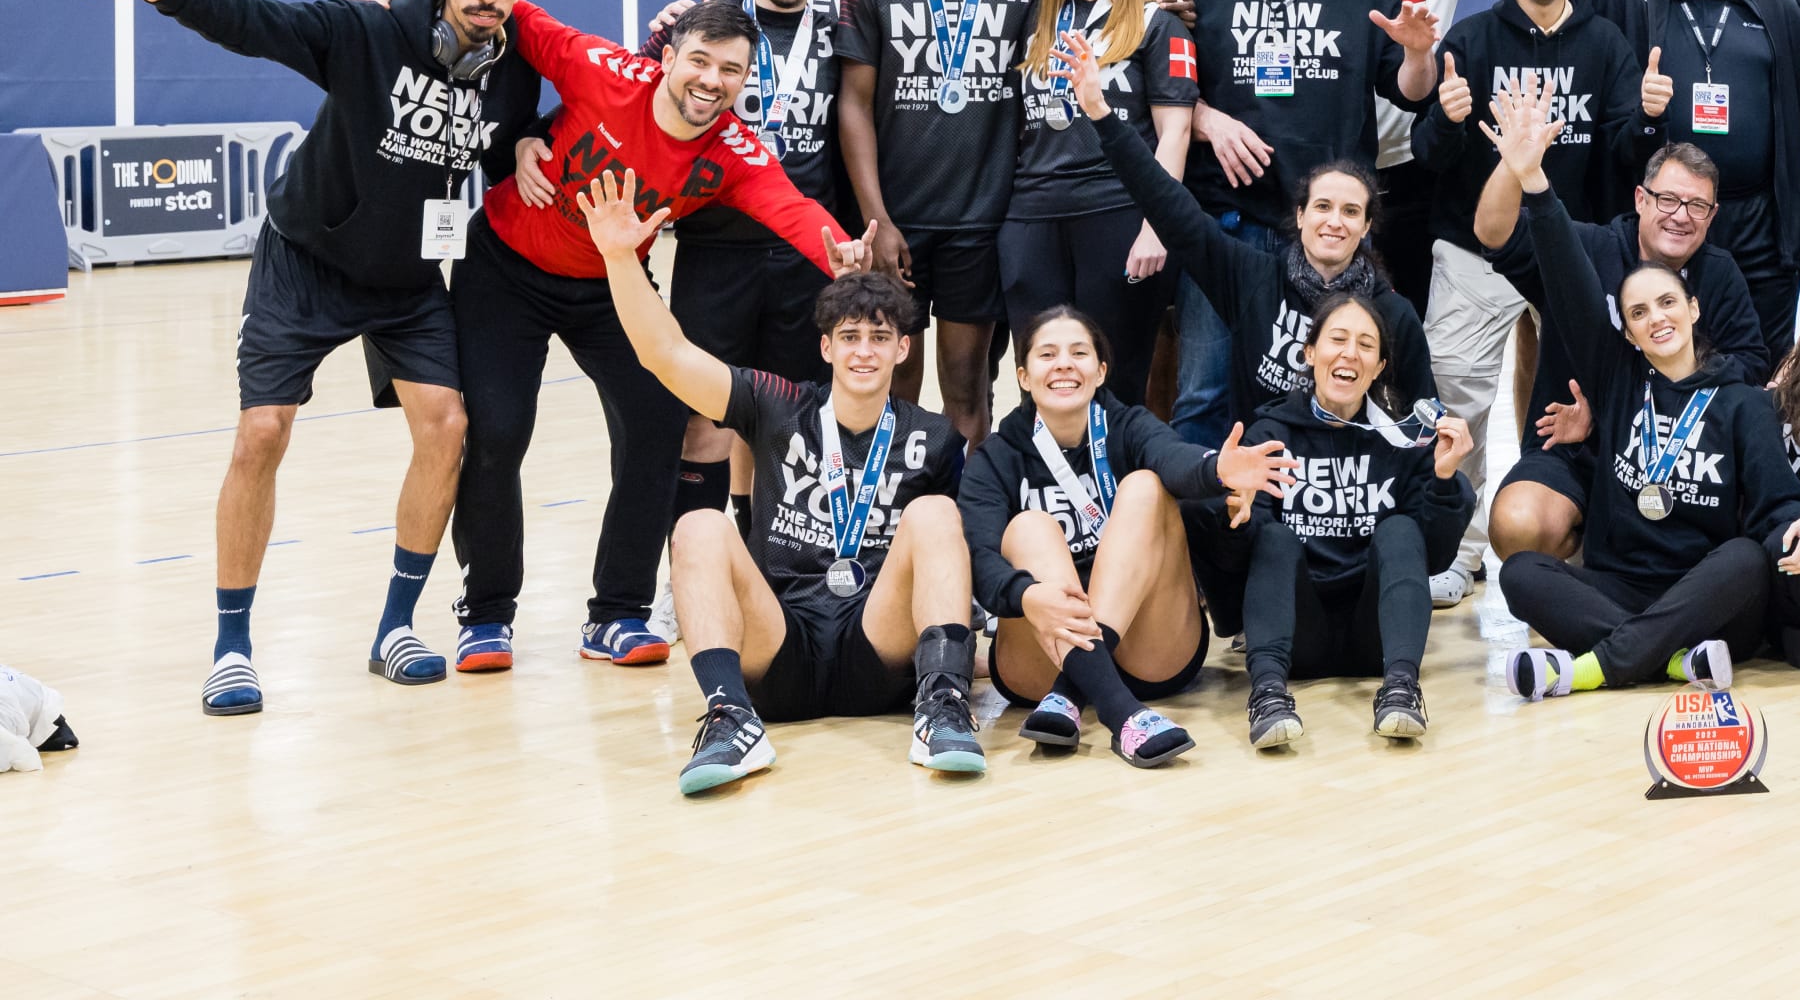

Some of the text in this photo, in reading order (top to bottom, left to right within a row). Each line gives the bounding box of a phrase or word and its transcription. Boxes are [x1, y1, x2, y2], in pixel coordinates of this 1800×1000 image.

[890, 1, 1007, 38] NEW
[1232, 2, 1322, 28] NEW
[817, 27, 833, 58] 5
[1230, 28, 1342, 57] YORK
[897, 76, 928, 89] THE
[1306, 69, 1339, 79] CLUB
[1493, 66, 1575, 94] NEW
[391, 66, 482, 118] NEW
[771, 101, 783, 114] USA
[390, 95, 499, 150] YORK
[386, 128, 407, 145] THE
[1561, 134, 1591, 144] CLUB
[380, 137, 445, 166] HANDBALL
[112, 159, 217, 187] THE PODIUM.
[130, 190, 212, 211] POWERED BY stcu
[1262, 354, 1284, 378] THE
[1684, 406, 1698, 428] verizon
[832, 452, 842, 469] USA
[871, 445, 883, 472] verizon
[905, 430, 927, 469] 6
[1280, 448, 1370, 489] NEW
[1615, 453, 1639, 477] THE
[1102, 473, 1113, 498] verizon
[1279, 477, 1396, 515] YORK
[835, 497, 845, 524] verizon
[1084, 503, 1099, 519] USA
[1681, 493, 1719, 507] CLUB
[777, 503, 807, 522] THE
[1307, 515, 1376, 528] WORLD'S
[768, 535, 802, 550] since 1973
[849, 519, 862, 545] verizon
[829, 571, 844, 579] USA
[1675, 692, 1712, 713] USA
[1675, 721, 1716, 729] HANDBALL
[1696, 731, 1716, 739] 2023
[1671, 750, 1741, 762] CHAMPIONSHIPS
[1672, 741, 1739, 753] OPEN NATIONAL
